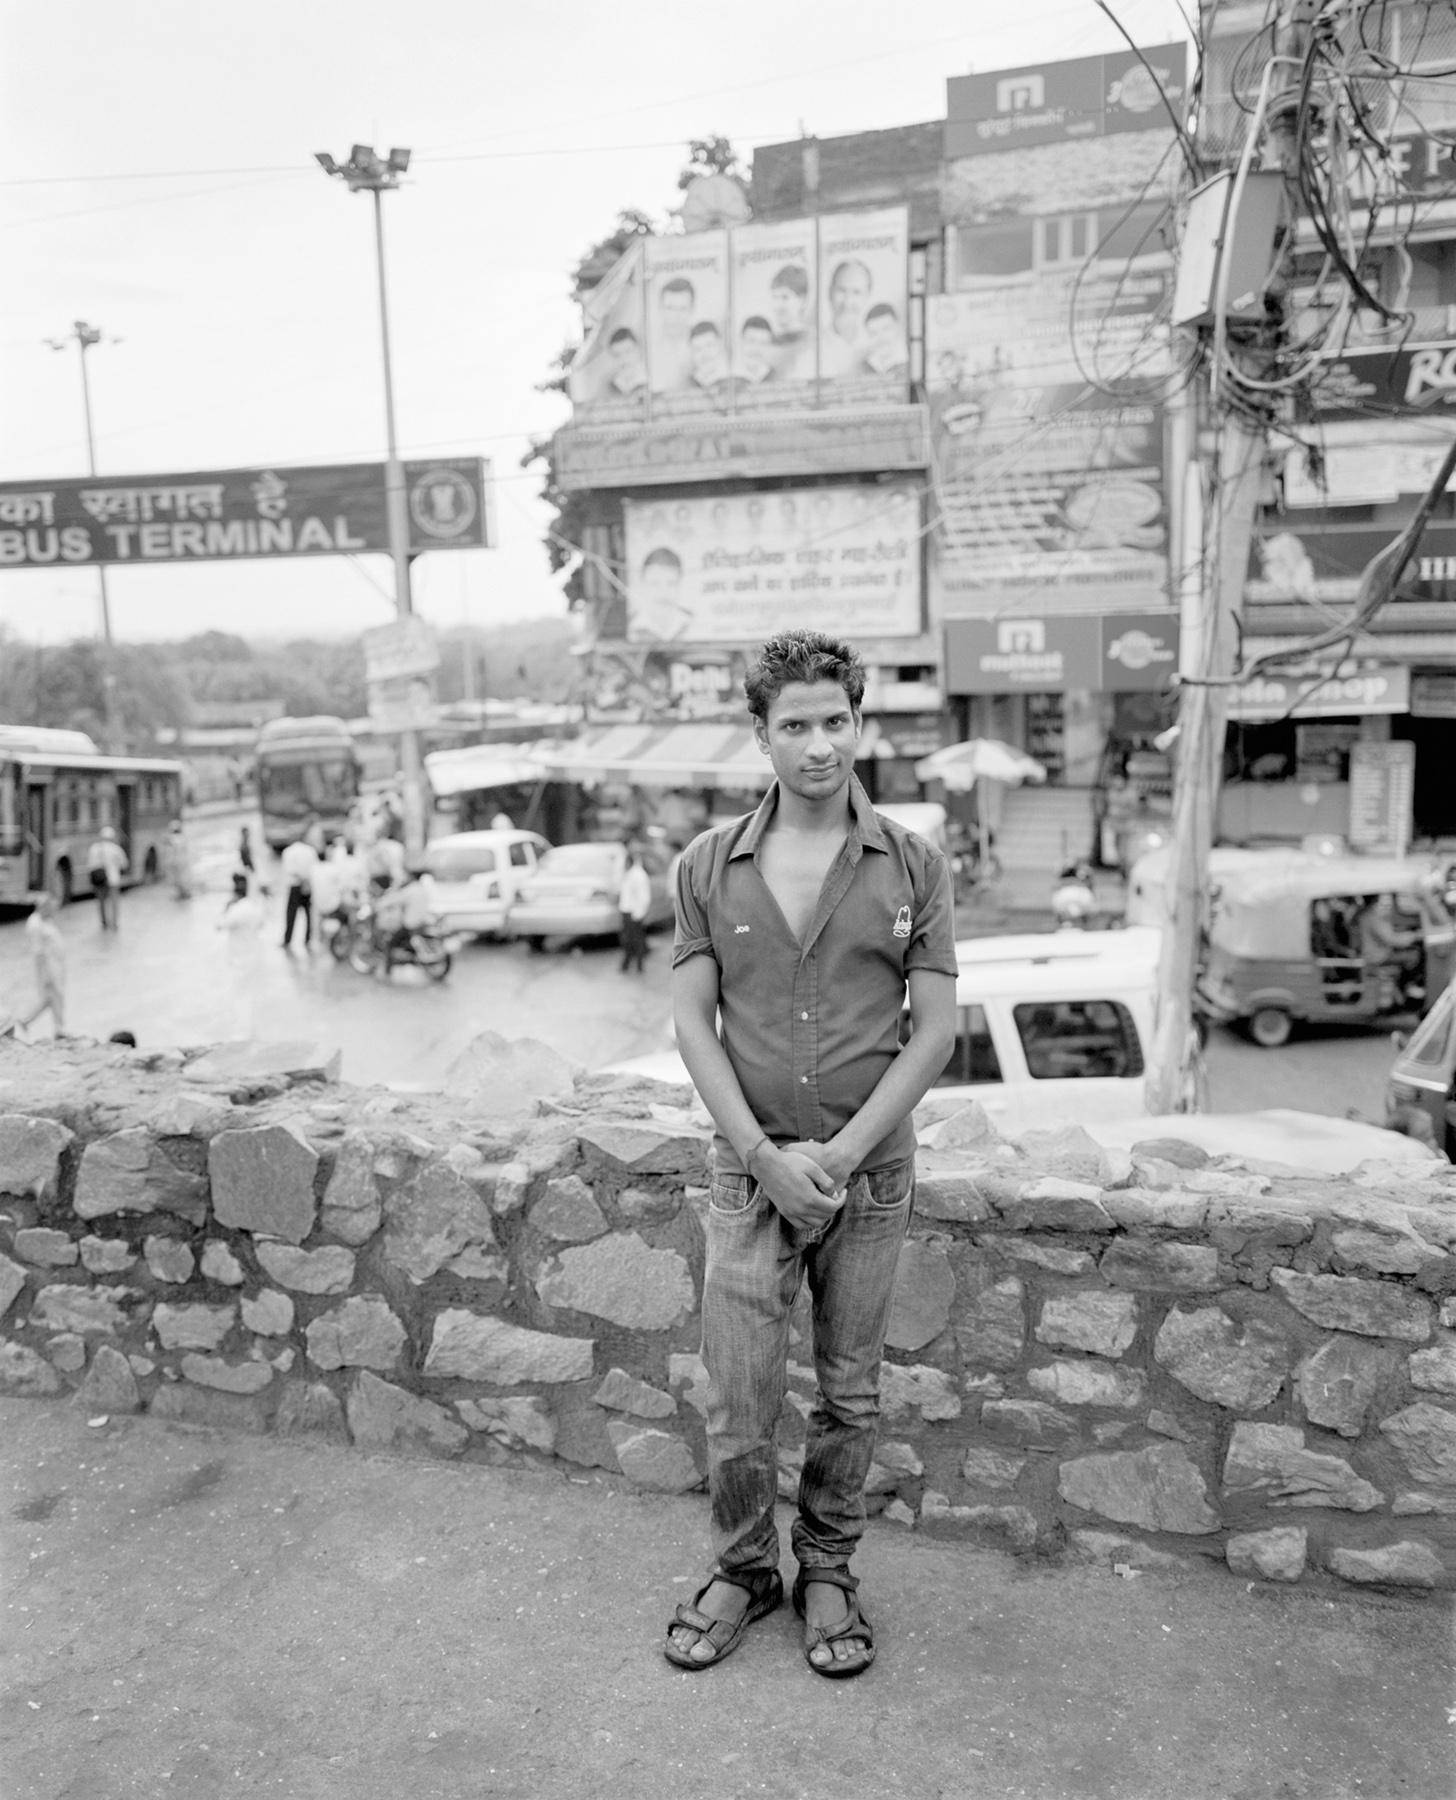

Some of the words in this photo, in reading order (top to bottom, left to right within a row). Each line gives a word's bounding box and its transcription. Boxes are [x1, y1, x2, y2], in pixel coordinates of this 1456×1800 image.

[79, 484, 225, 523] स्वागत
[249, 470, 289, 520] है
[0, 527, 92, 563] BUS
[106, 515, 366, 560] TERMINAL
[734, 924, 750, 934] Joe
